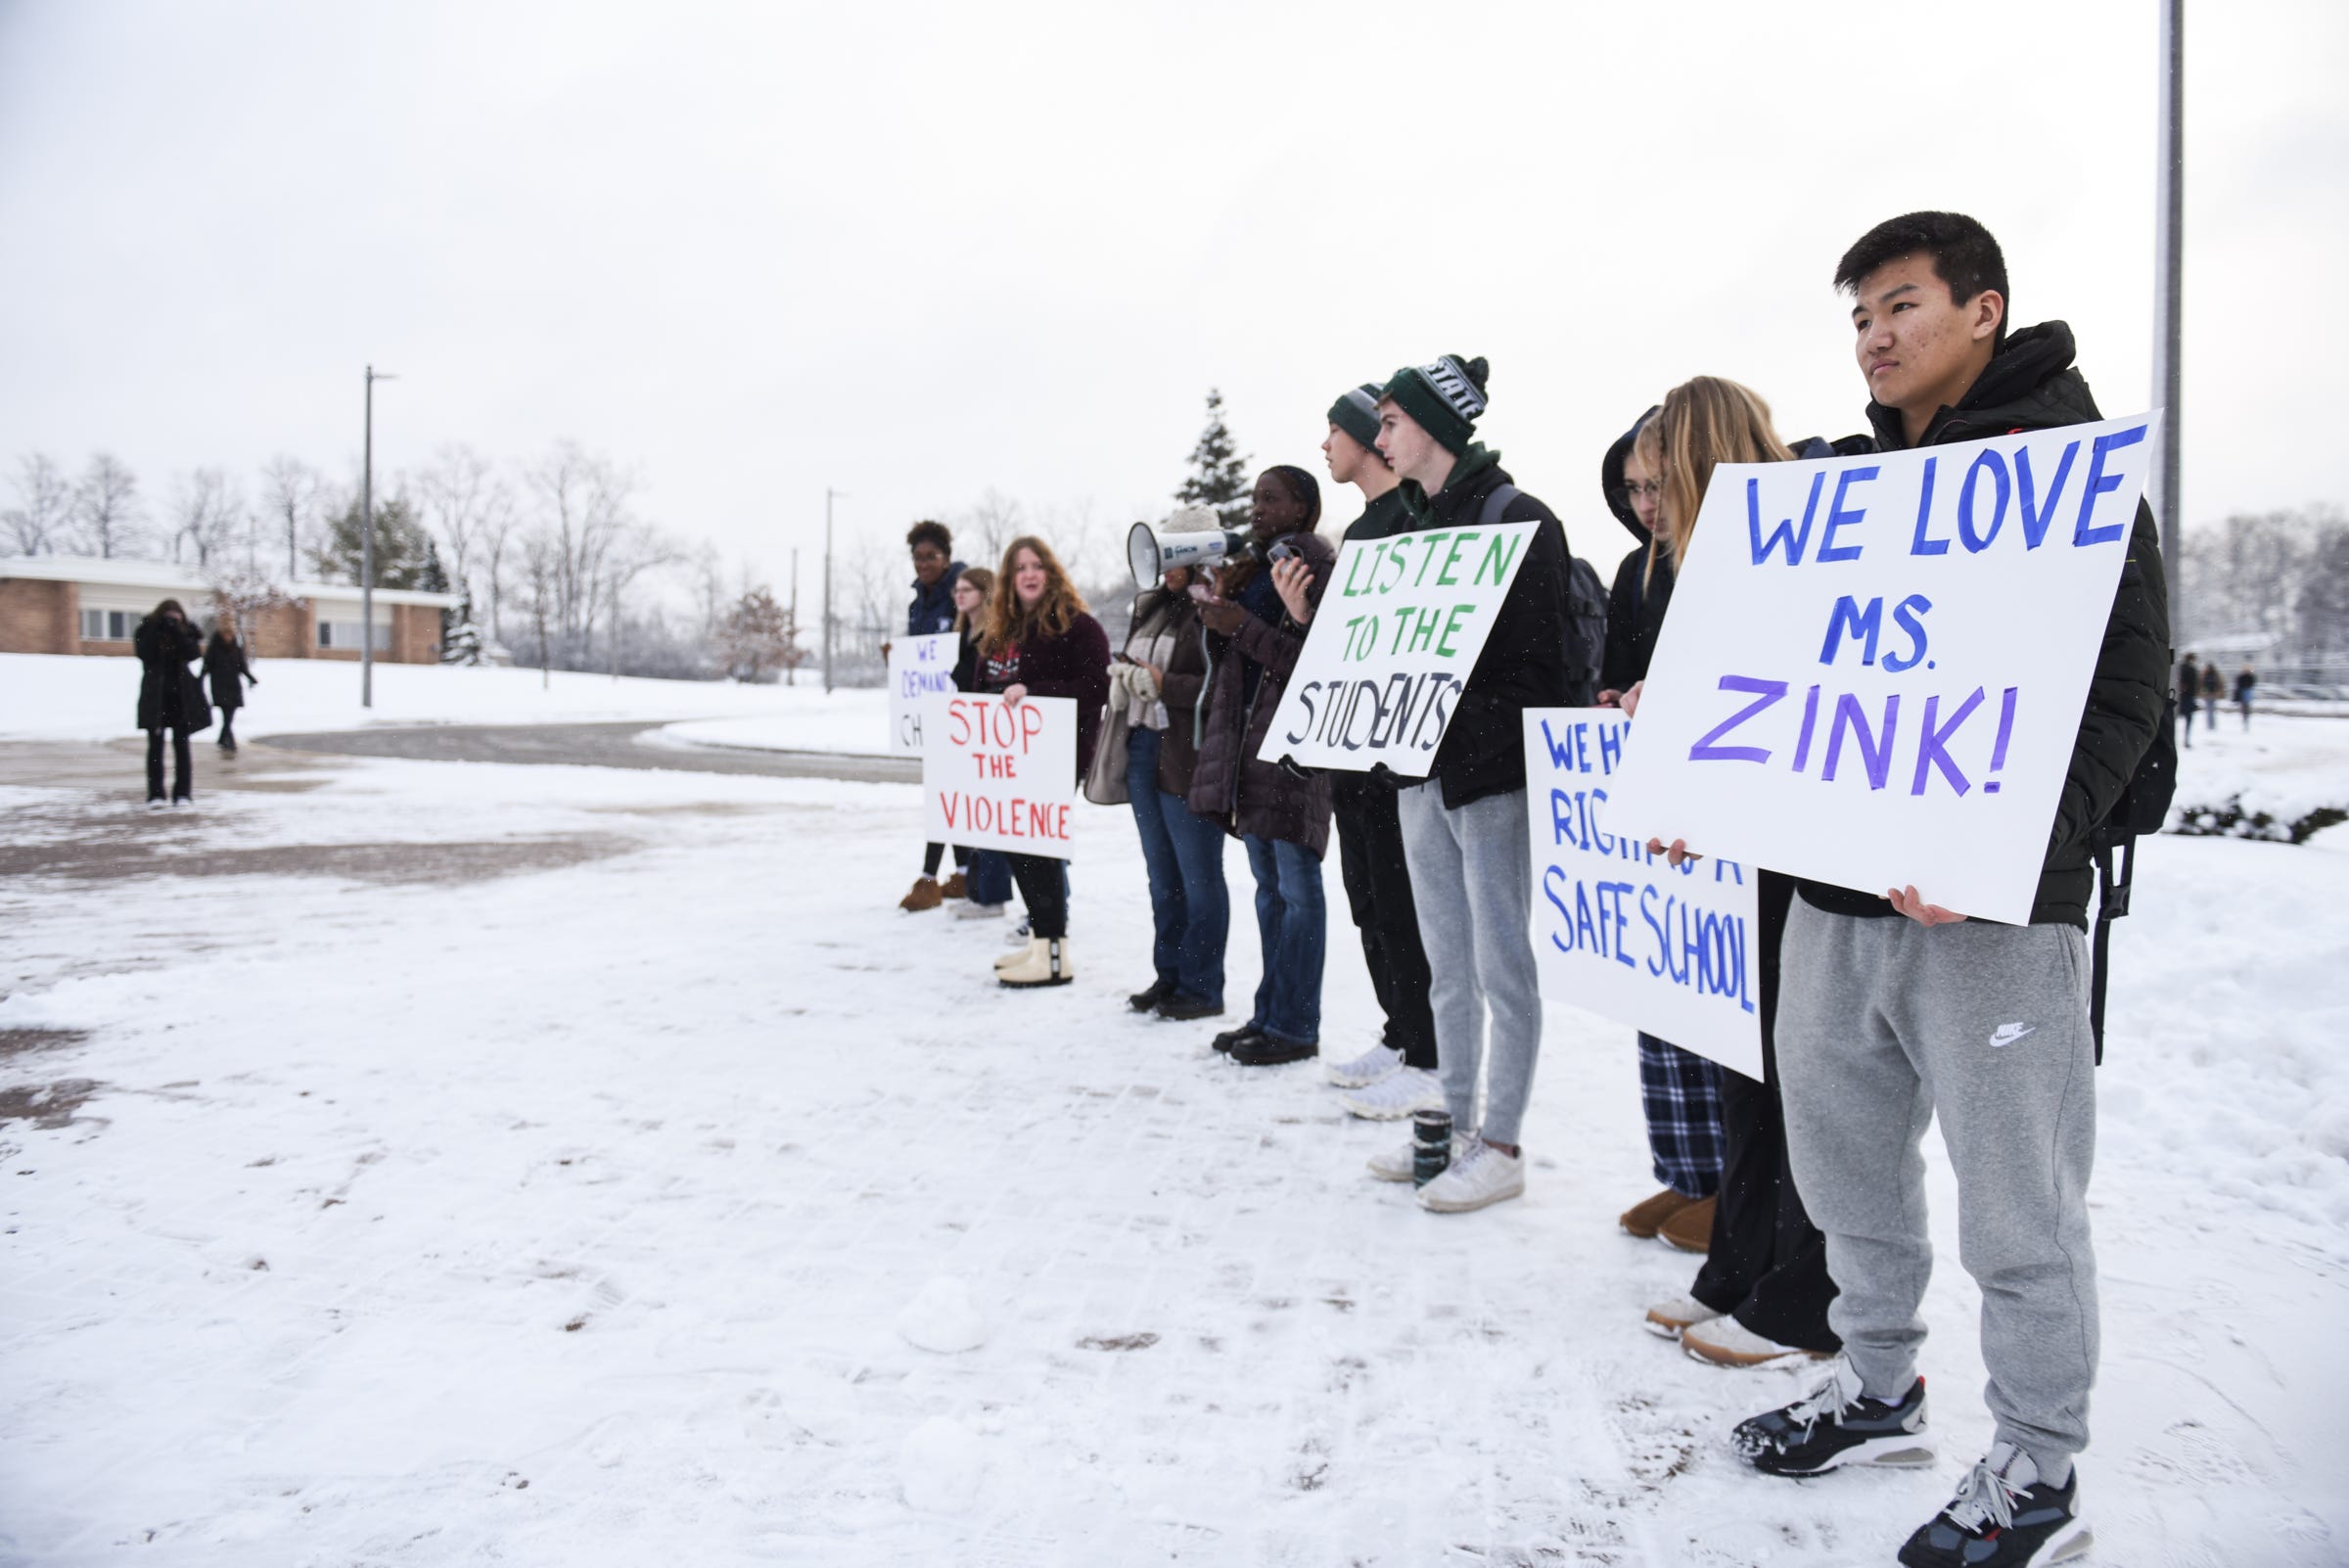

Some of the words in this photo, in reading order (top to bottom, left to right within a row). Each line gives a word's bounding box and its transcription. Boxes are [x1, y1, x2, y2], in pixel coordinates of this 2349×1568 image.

[1746, 466, 1881, 566] WE
[1911, 424, 2148, 556] LOVE
[1342, 531, 1522, 598] LISTEN
[917, 638, 937, 661] WE
[1342, 615, 1380, 663] TO
[1390, 604, 1477, 658] THE
[1819, 594, 1936, 673] MS.
[948, 699, 1043, 755] STOP
[1285, 672, 1463, 752] STUDENTS
[1687, 674, 2019, 799] ZINK!
[972, 753, 1017, 779] THE
[1541, 718, 1592, 774] WE
[940, 790, 1071, 840] VIOLENCE
[1550, 788, 1653, 866] RIG
[1543, 864, 1636, 969] SAFE
[1639, 884, 1756, 1014] SCHOOL
